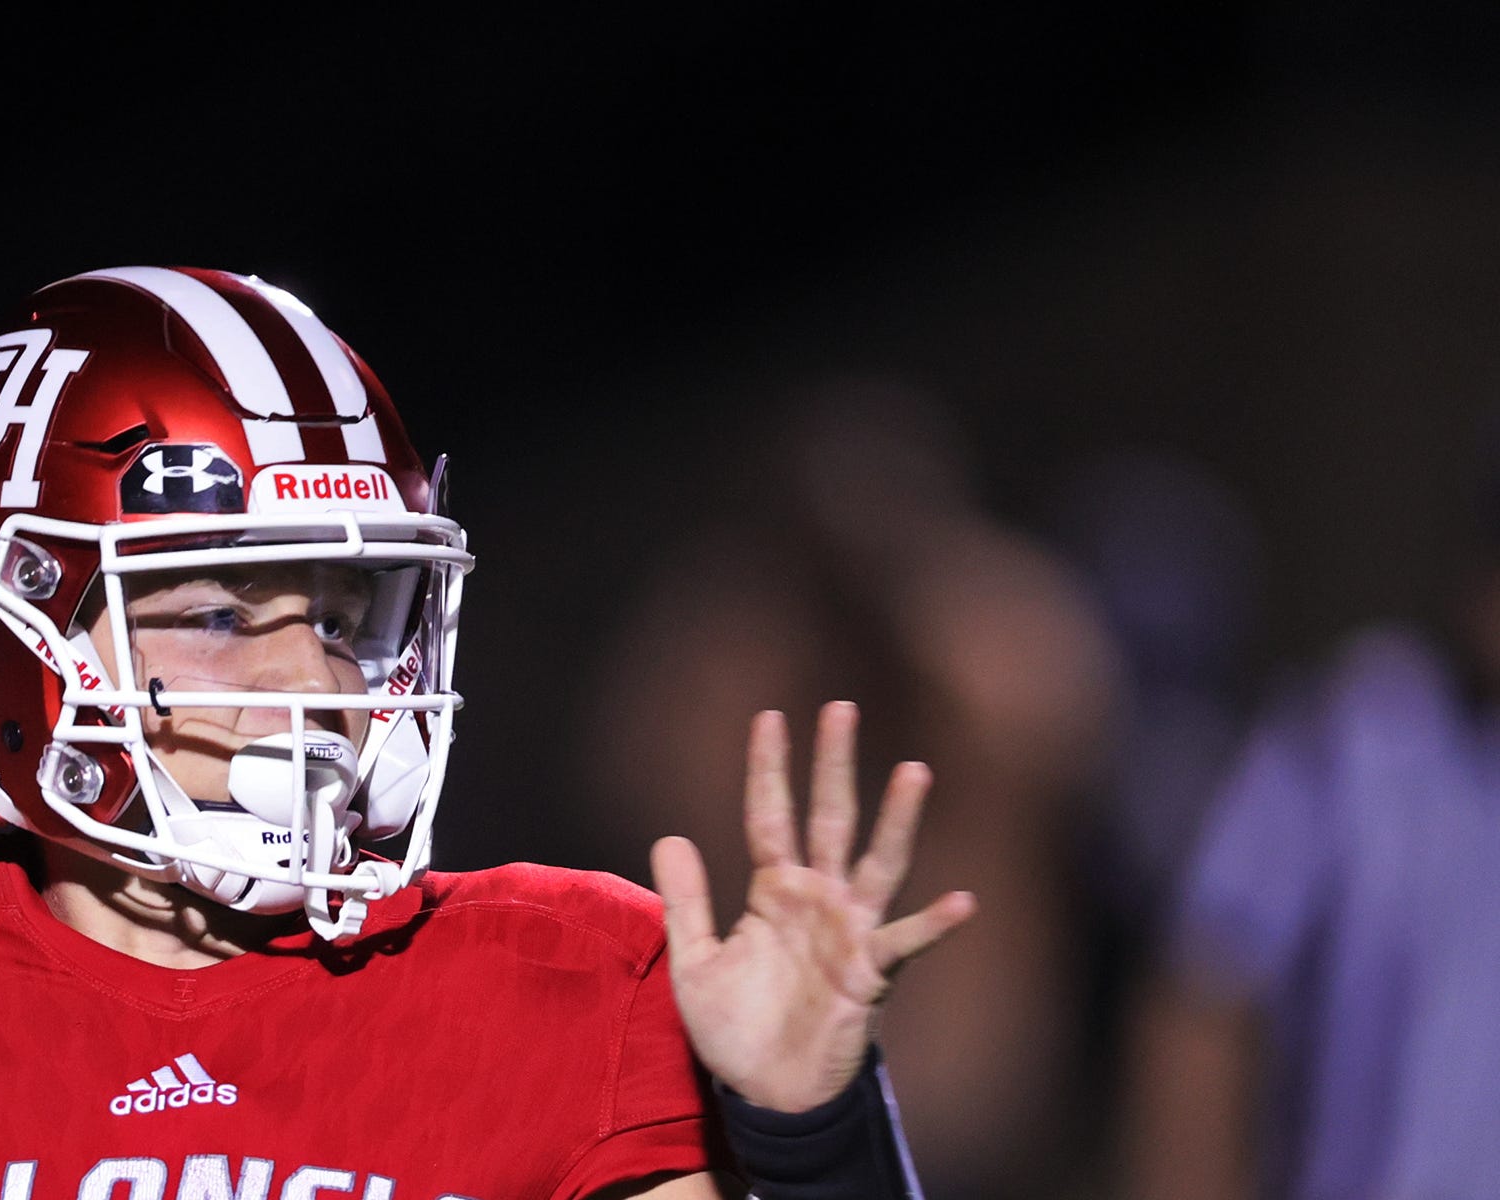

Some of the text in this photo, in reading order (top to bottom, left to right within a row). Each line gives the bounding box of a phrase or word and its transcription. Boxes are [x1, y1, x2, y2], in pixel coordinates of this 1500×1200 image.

[273, 472, 389, 500] Riddell
[370, 638, 422, 723] Rddell
[109, 1083, 238, 1116] adidas
